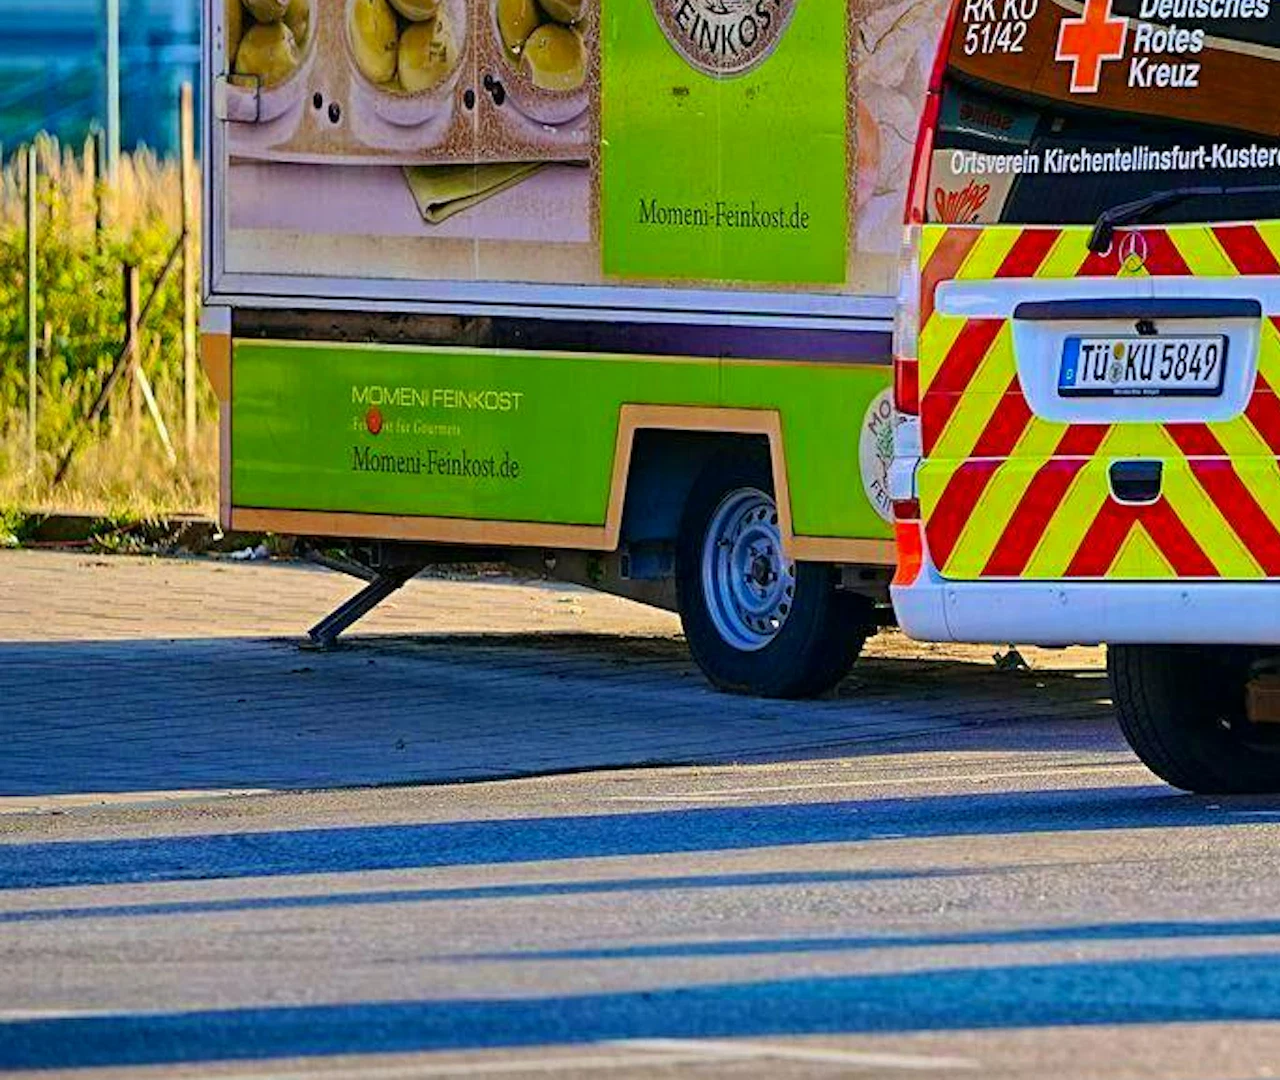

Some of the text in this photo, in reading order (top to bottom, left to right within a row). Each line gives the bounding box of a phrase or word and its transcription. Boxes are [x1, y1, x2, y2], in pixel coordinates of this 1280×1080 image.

[964, 21, 1027, 55] 51/42
[1133, 23, 1205, 54] Rotes
[1128, 57, 1201, 88] Kreuz
[951, 148, 1039, 175] Ortsverein
[638, 197, 811, 230] Momeni-Feinkost.de
[1081, 343, 1110, 382] TÜ
[1124, 342, 1157, 382] KU
[1160, 341, 1218, 382] 5849
[351, 385, 524, 412] MOMENI FEINKOST
[352, 446, 520, 479] Momeni-Feinkost.de
